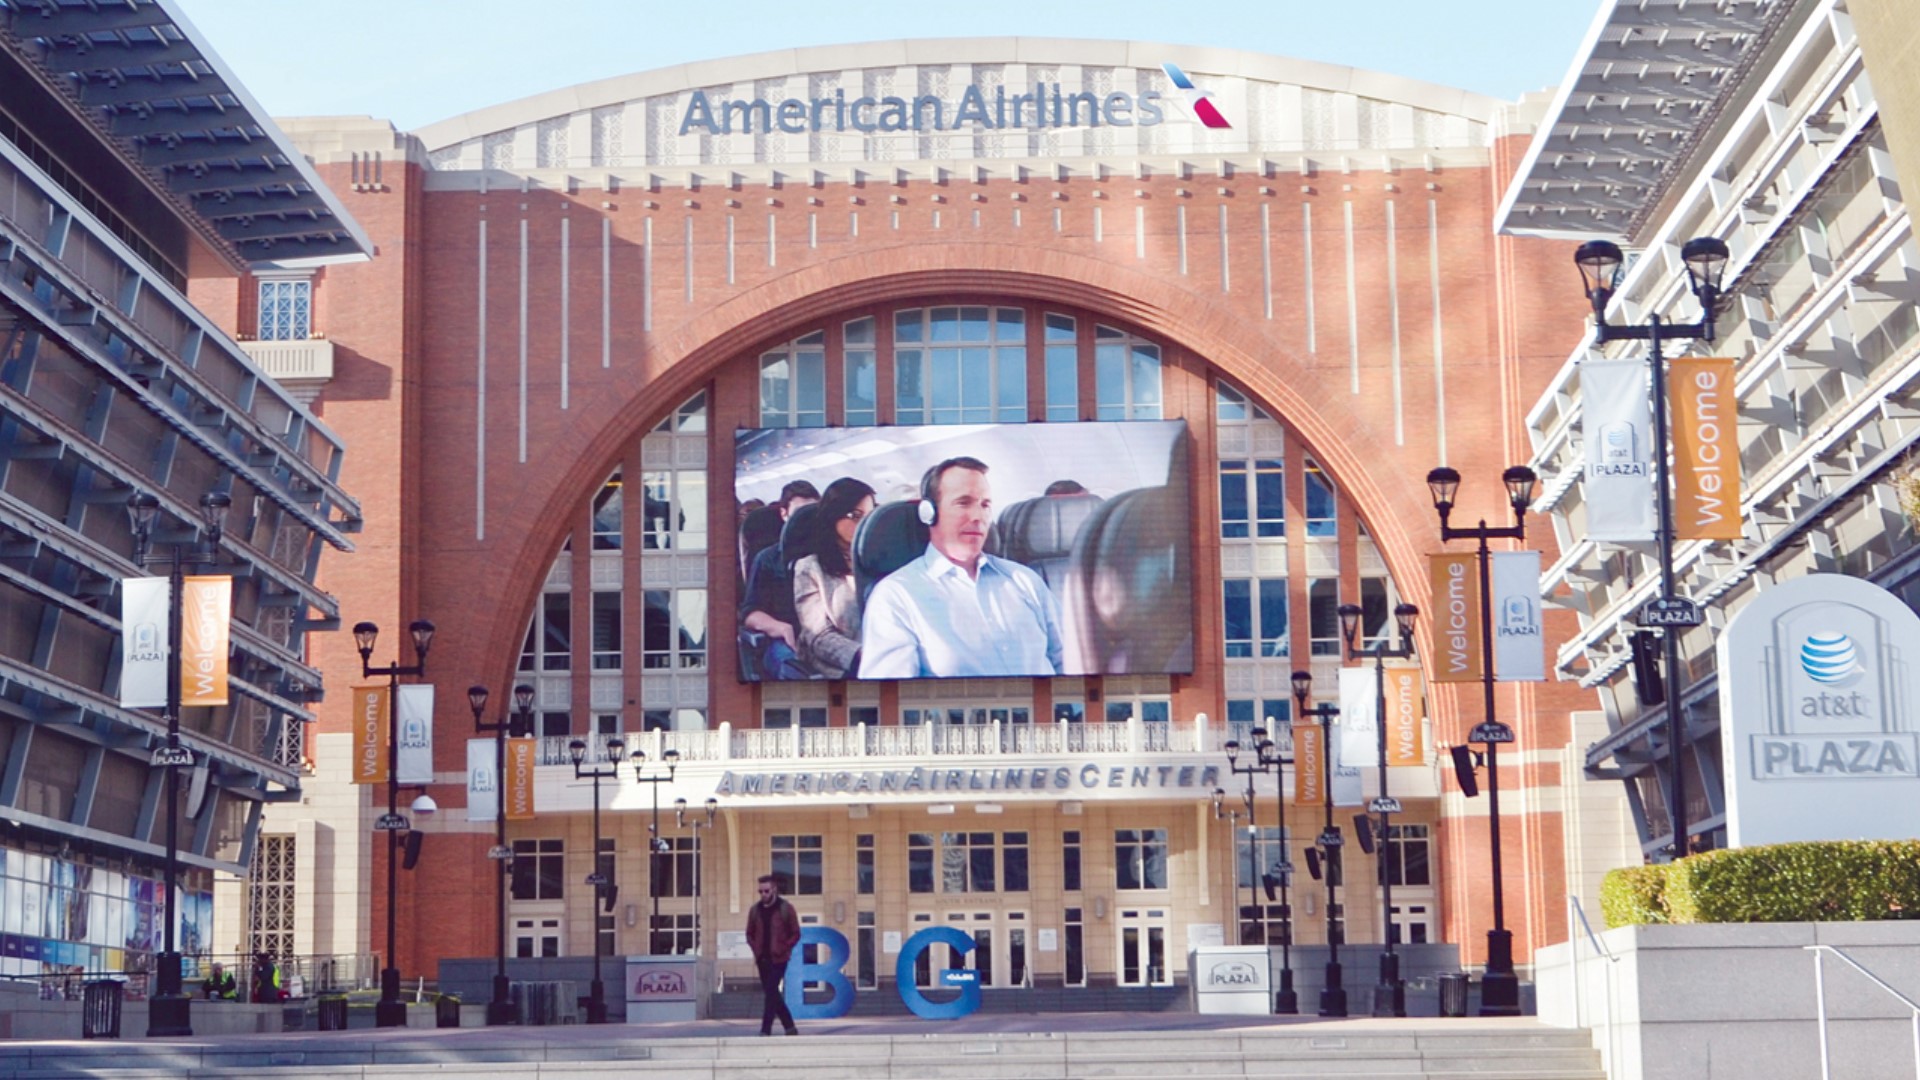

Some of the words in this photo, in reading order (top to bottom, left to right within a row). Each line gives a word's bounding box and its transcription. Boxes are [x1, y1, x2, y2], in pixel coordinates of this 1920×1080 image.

[678, 87, 941, 135] American
[953, 82, 1163, 131] Airlines
[1692, 370, 1723, 526] Welcome
[1596, 463, 1642, 476] PLAZA
[1446, 562, 1467, 673] Welcome
[1502, 626, 1535, 636] PLAZA
[1649, 611, 1693, 623] PLAZA
[195, 586, 217, 697] Welcome
[129, 652, 161, 662] PLAZA
[1397, 674, 1415, 759] Welcome
[1801, 690, 1863, 717] at&t
[363, 692, 379, 777] Welcome
[403, 741, 426, 749] PLAZA
[1476, 731, 1508, 741] PLAZA
[157, 755, 187, 765] PLAZA
[1304, 730, 1316, 800] Welcome
[1763, 740, 1906, 774] PLAZA
[515, 743, 528, 814] Welcome
[715, 769, 898, 795] AMERICAN
[902, 766, 1071, 791] AIRLINES
[1080, 763, 1221, 788] CENTER
[380, 820, 404, 828] PLAZA
[783, 925, 856, 1020] B
[896, 926, 981, 1019] G
[1215, 974, 1252, 984] PLAZA
[643, 983, 679, 993] PLAZA
